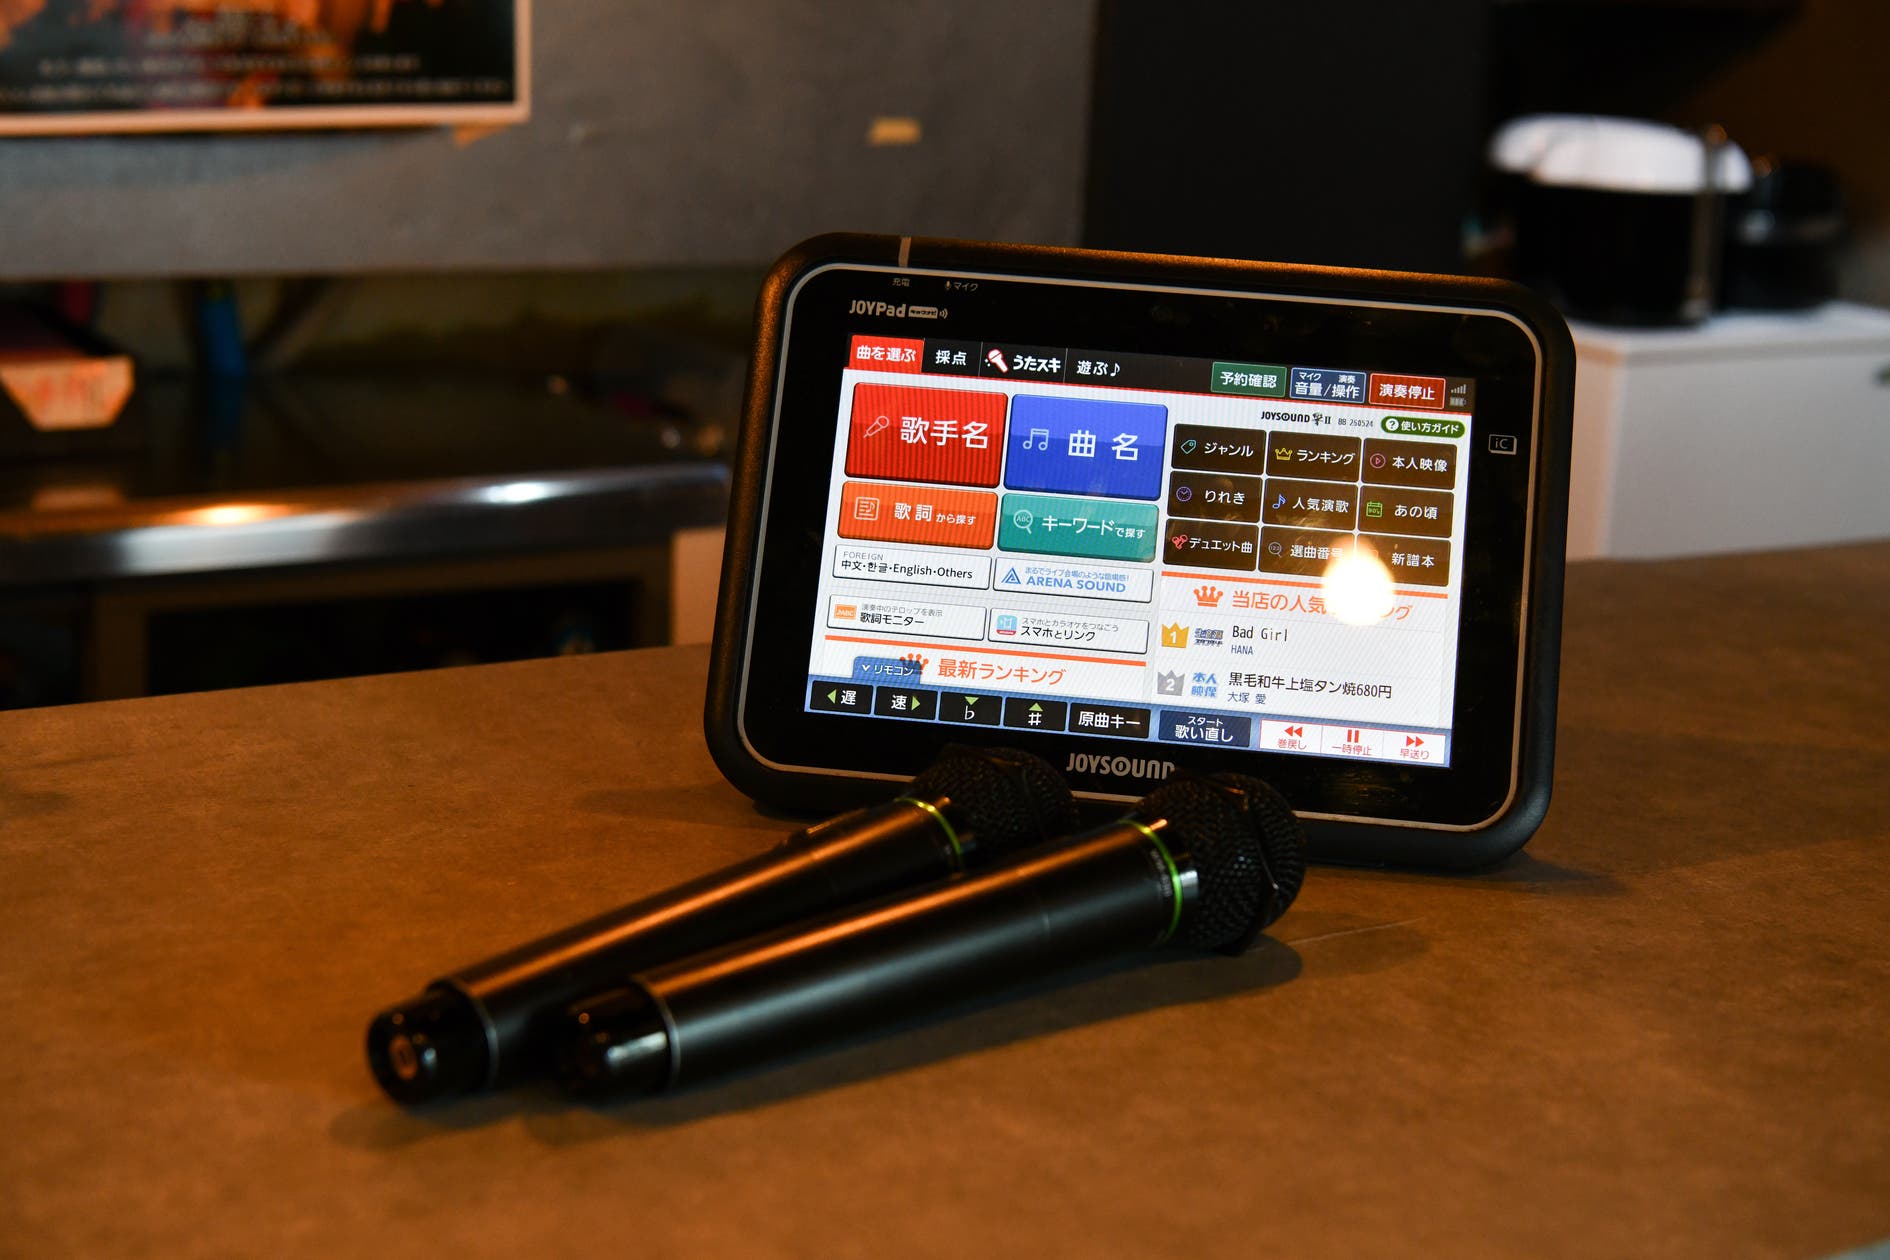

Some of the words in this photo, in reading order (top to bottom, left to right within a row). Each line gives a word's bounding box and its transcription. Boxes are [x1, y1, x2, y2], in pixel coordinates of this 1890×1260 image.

[953, 281, 978, 292] マイク
[849, 299, 907, 318] JOYPad
[856, 344, 916, 363] 曲を選ぶ
[935, 350, 967, 366] 採点
[1013, 355, 1061, 373] うたスキ
[1220, 371, 1277, 388] 予約確認
[1299, 372, 1322, 381] マイク
[1338, 374, 1355, 384] 演奏
[1379, 384, 1436, 401] 演奏停止
[1261, 411, 1310, 423] JOYSOUND
[900, 416, 989, 449] 歌手名
[1401, 421, 1459, 435] 使い方ガイド
[1068, 429, 1139, 461] 曲名
[1204, 442, 1254, 457] ジャンル
[1297, 449, 1356, 466] ランキング
[1392, 457, 1448, 473] 本人映像
[1204, 490, 1246, 505] りれき
[1293, 498, 1349, 513] 人気演歌
[1394, 504, 1438, 520] あの頃
[1189, 537, 1252, 553] デュエット曲
[843, 550, 884, 562] FOREIGN
[1391, 552, 1434, 567] 新譜本
[1026, 576, 1072, 589] ARENA
[1077, 579, 1126, 593] SOUND
[860, 612, 924, 626] 歌詞モニター
[1021, 626, 1096, 641] スマホとリンク
[1169, 631, 1178, 644] 1
[1232, 625, 1254, 639] Bad
[1260, 628, 1289, 642] Girl
[1231, 644, 1254, 656] HANA
[874, 663, 914, 677] リモコン
[938, 658, 1067, 686] 最新ランキング
[1165, 679, 1175, 691] 2
[1192, 672, 1218, 684] 本人
[1228, 672, 1392, 699] 黒毛和牛上塩タン焼680円
[841, 690, 856, 705] 遅
[1191, 685, 1217, 698] 映像
[891, 694, 907, 710] 速
[1078, 711, 1141, 729] 原曲キー
[1187, 715, 1224, 726] スタート
[1174, 724, 1234, 743] 歌い直し
[1277, 738, 1307, 750] 巻戻し
[1332, 743, 1372, 757] 一時停止
[1400, 747, 1430, 760] 早送り
